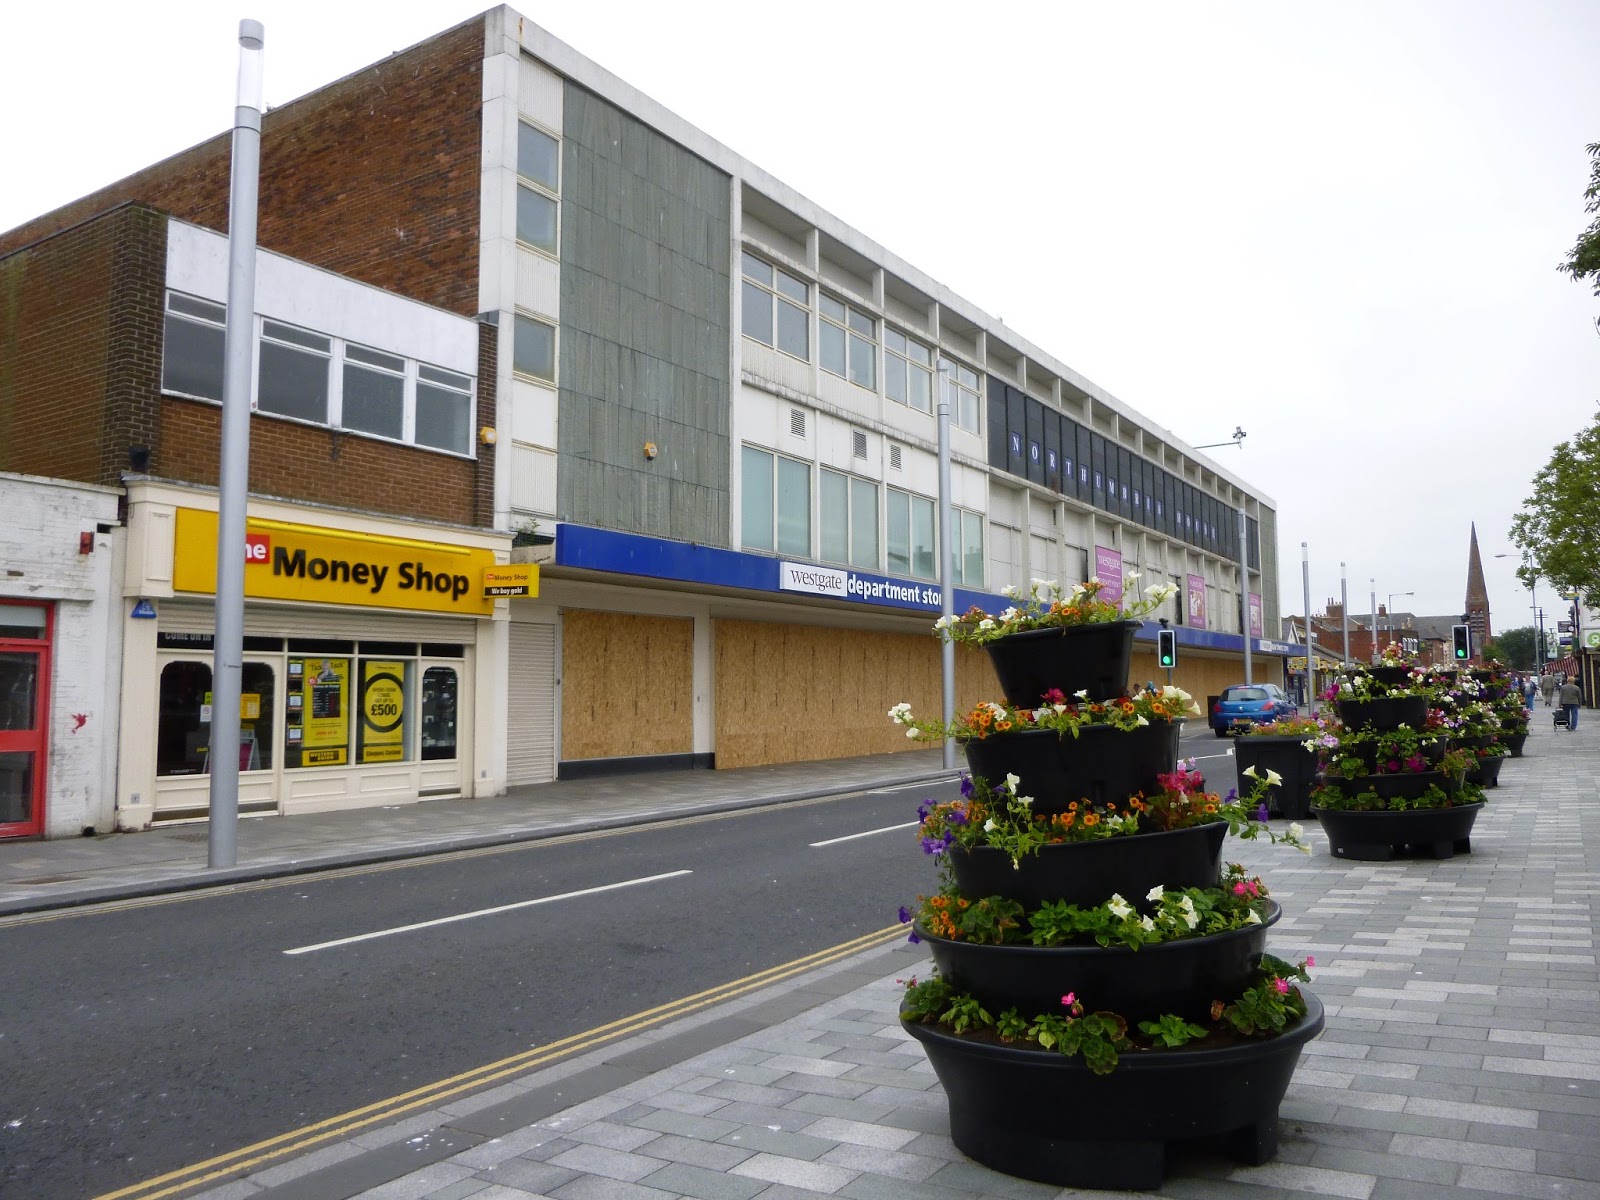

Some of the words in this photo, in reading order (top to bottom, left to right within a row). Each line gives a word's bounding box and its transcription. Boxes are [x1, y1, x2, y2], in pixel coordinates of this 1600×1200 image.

[1012, 436, 1161, 515] NORTHUMBRIA
[273, 546, 389, 594] Money
[398, 562, 469, 601] Shop
[494, 574, 513, 582] Money
[514, 573, 528, 582] Shop
[500, 587, 510, 596] buy
[511, 586, 523, 595] gold
[790, 569, 842, 592] Westgate
[847, 574, 920, 603] department
[371, 703, 398, 716] £500
